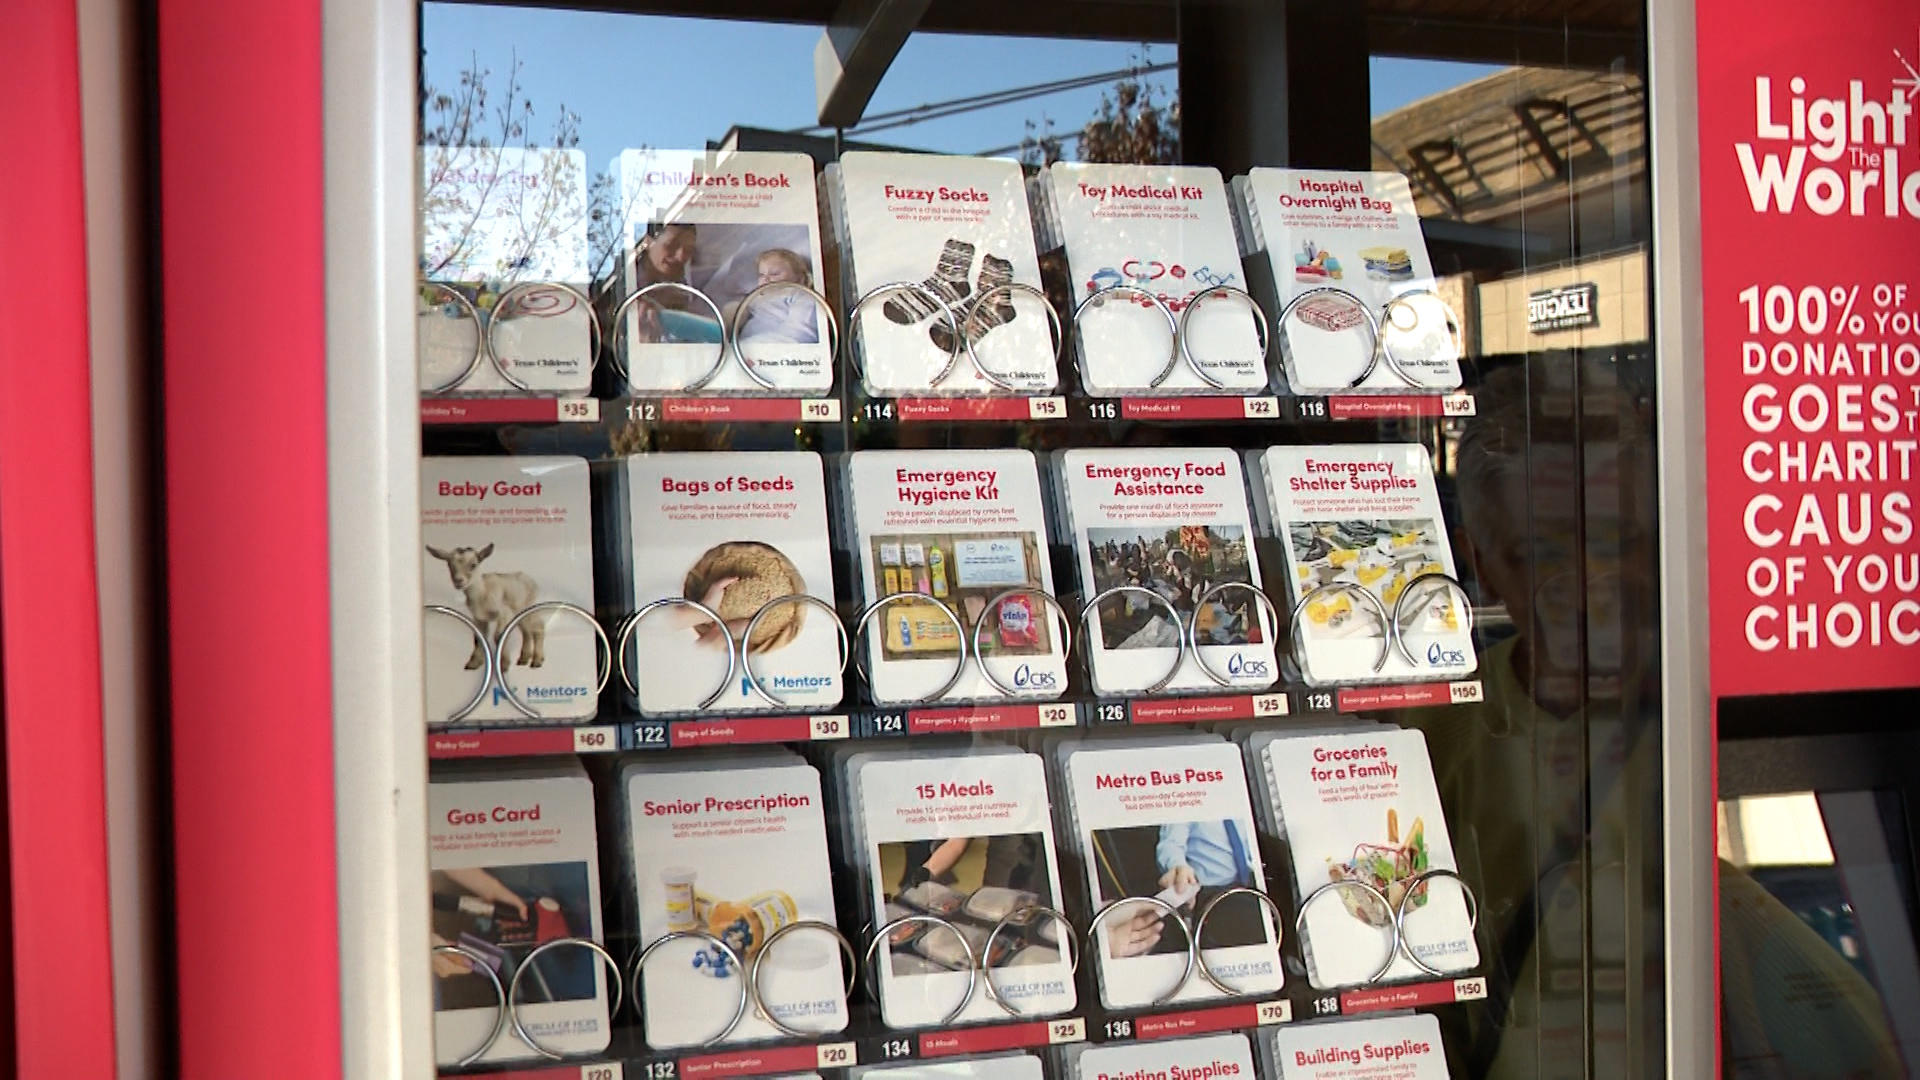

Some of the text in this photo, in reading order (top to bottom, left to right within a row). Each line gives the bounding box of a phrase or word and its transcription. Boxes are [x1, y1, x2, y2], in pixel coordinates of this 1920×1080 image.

[1755, 75, 1913, 163] Light
[1847, 146, 1881, 168] The
[647, 171, 791, 188] Children's Book
[1299, 179, 1364, 196] Hospital
[884, 184, 990, 204] Fuzzy Socks
[1078, 182, 1204, 201] Toy Medical Kit
[1279, 194, 1393, 214] Overnight Bag
[1738, 282, 1908, 336] 100% OF
[1741, 340, 1920, 377] DONATIO
[564, 402, 590, 418] $35
[625, 404, 656, 421] 112
[808, 403, 830, 417] $10
[864, 402, 892, 421] 114
[1036, 401, 1057, 415] $15
[1089, 402, 1116, 419] 116
[1249, 400, 1271, 414] $22
[1299, 401, 1325, 417] 118
[1741, 382, 1901, 433] GOES
[1304, 458, 1395, 478] Emergency
[1741, 440, 1919, 482] CHARIT
[896, 467, 998, 488] Emergency
[1085, 461, 1227, 482] Emergency Food
[438, 480, 543, 501] Baby Goat
[661, 474, 796, 496] Bags of Seeds
[1112, 481, 1205, 496] Assistance
[1289, 474, 1417, 494] Shelter Supplies
[898, 484, 1001, 506] Hygiene Kit
[1742, 490, 1914, 548] CAUS
[1746, 556, 1807, 598] OF
[1744, 599, 1920, 652] CHOIC
[1243, 659, 1269, 675] CRS
[773, 676, 832, 689] Mentors
[1030, 671, 1057, 687] CRS
[526, 685, 588, 698] Mentors
[1452, 686, 1477, 699] $150
[1258, 699, 1280, 713] $25
[1306, 693, 1333, 710] 128
[1045, 708, 1067, 721] $20
[1097, 705, 1125, 721] 126
[816, 720, 839, 736] $30
[873, 714, 903, 732] 124
[579, 732, 606, 746] $60
[635, 725, 666, 742] 122
[1313, 743, 1388, 763] Groceries
[1096, 767, 1224, 790] Metro Bus Pass
[1310, 761, 1399, 782] for a Family
[915, 779, 995, 800] 15 Meals
[643, 792, 810, 817] Senior Prescription
[447, 803, 541, 826] Gas Card
[1456, 983, 1481, 995] $150
[1262, 1005, 1284, 1018] $70
[1312, 996, 1340, 1014] 138
[1054, 1025, 1076, 1038] $25
[1104, 1020, 1131, 1038] 136
[823, 1050, 848, 1064] $20
[882, 1039, 911, 1057] 134
[1295, 1038, 1431, 1067] Building Supplies
[645, 1062, 675, 1080] 132
[1169, 1058, 1241, 1080] Supplies
